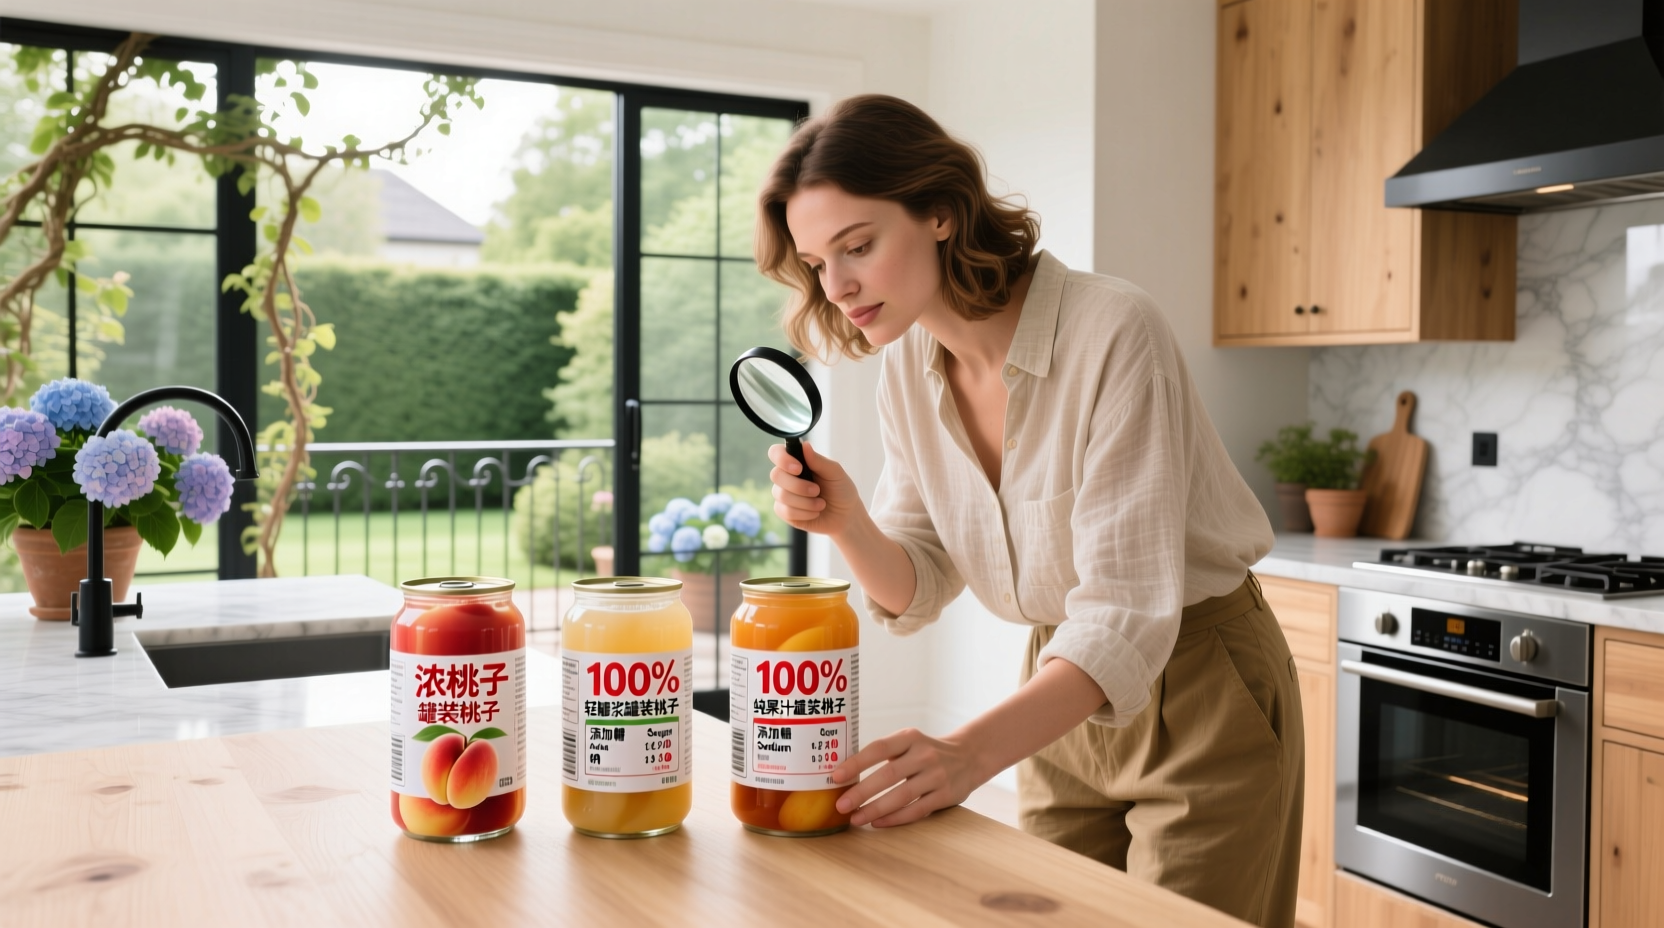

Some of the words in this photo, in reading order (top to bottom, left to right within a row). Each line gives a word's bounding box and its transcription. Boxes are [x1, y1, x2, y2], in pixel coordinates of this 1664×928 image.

[414, 662, 509, 699] 浓桃子
[586, 658, 681, 697] 100%
[756, 658, 848, 696] 100%
[417, 700, 500, 724] 罐装桃子
